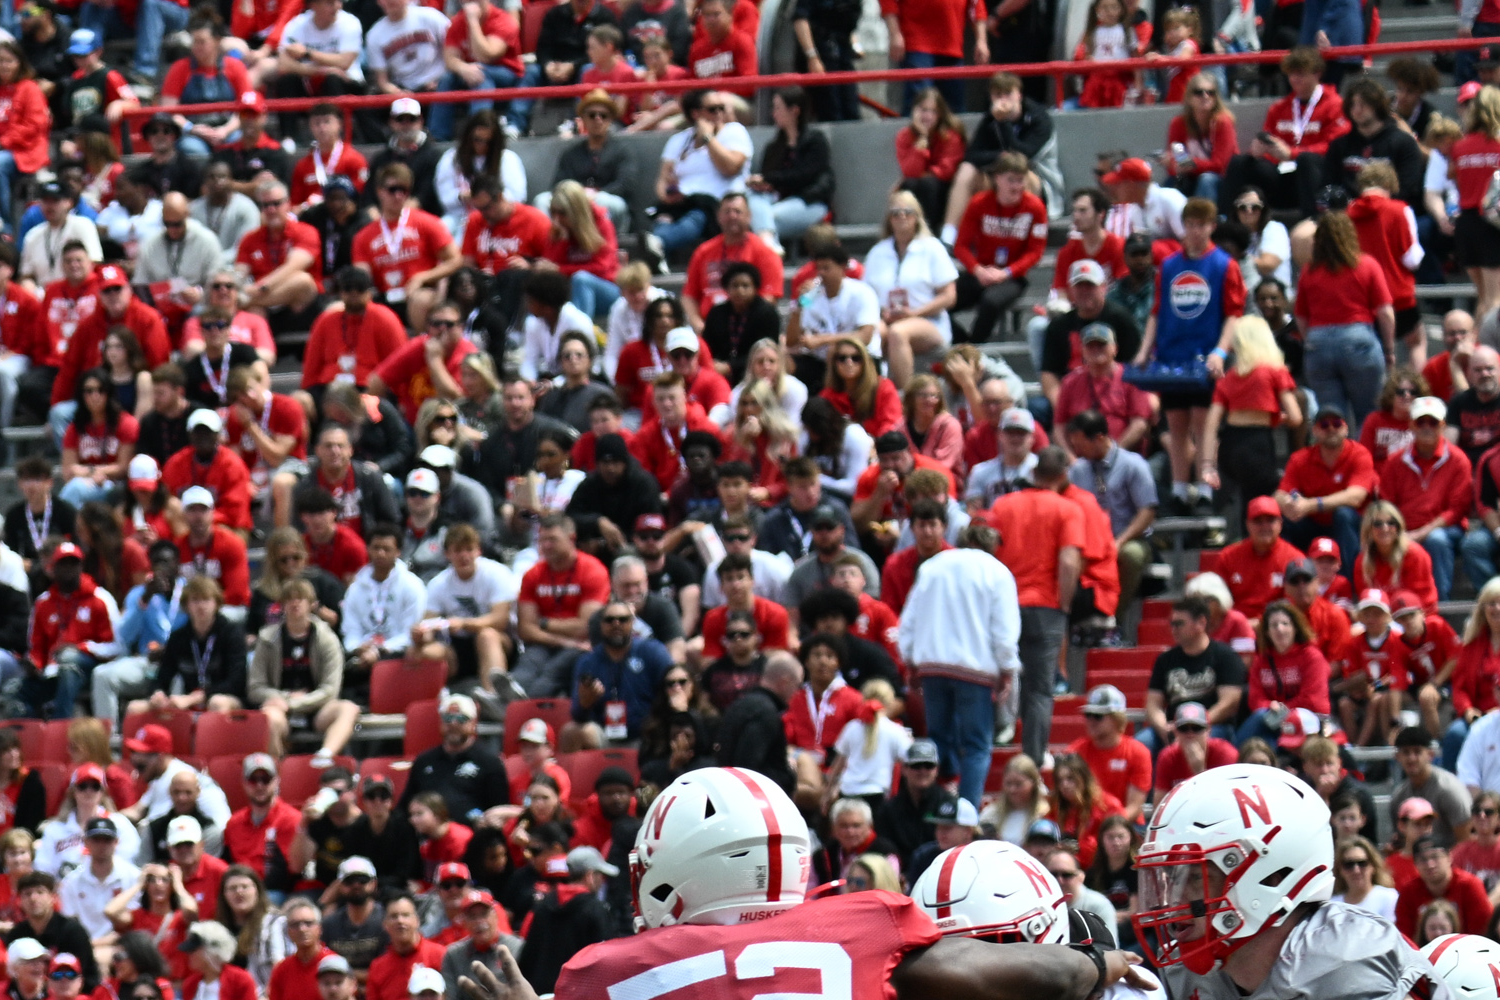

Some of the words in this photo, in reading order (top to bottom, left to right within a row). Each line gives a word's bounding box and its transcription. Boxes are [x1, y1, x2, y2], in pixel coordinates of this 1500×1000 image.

[643, 795, 678, 841] N
[1234, 784, 1273, 829] N
[1013, 859, 1053, 899] N
[739, 909, 788, 922] HUSKE
